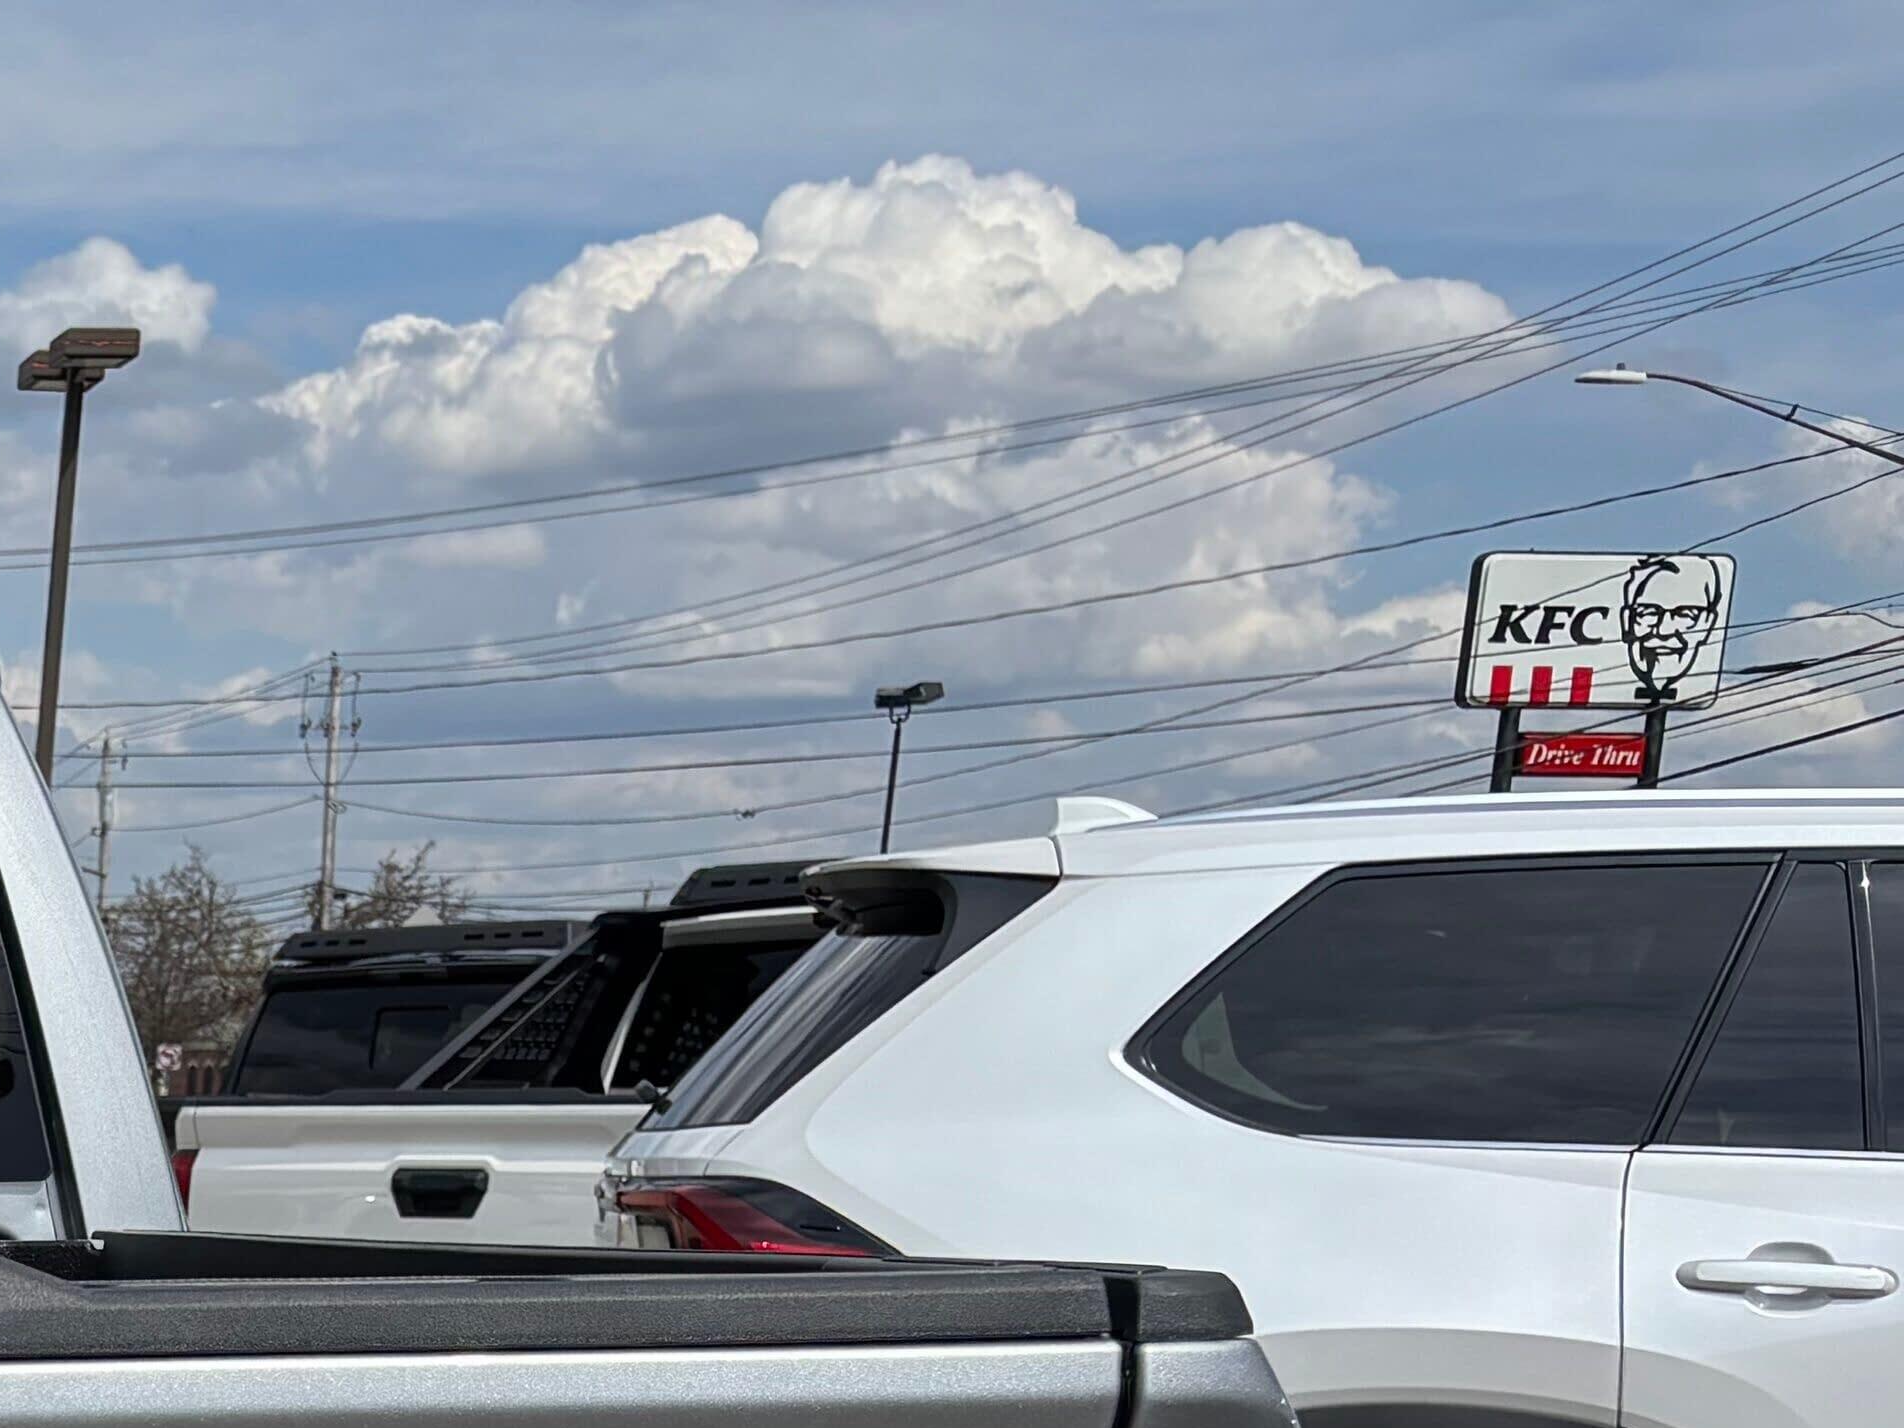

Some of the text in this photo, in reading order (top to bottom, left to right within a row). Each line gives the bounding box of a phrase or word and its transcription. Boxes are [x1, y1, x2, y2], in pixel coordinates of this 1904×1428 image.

[1488, 604, 1610, 645] KFC
[1527, 743, 1641, 767] Drive Thru
